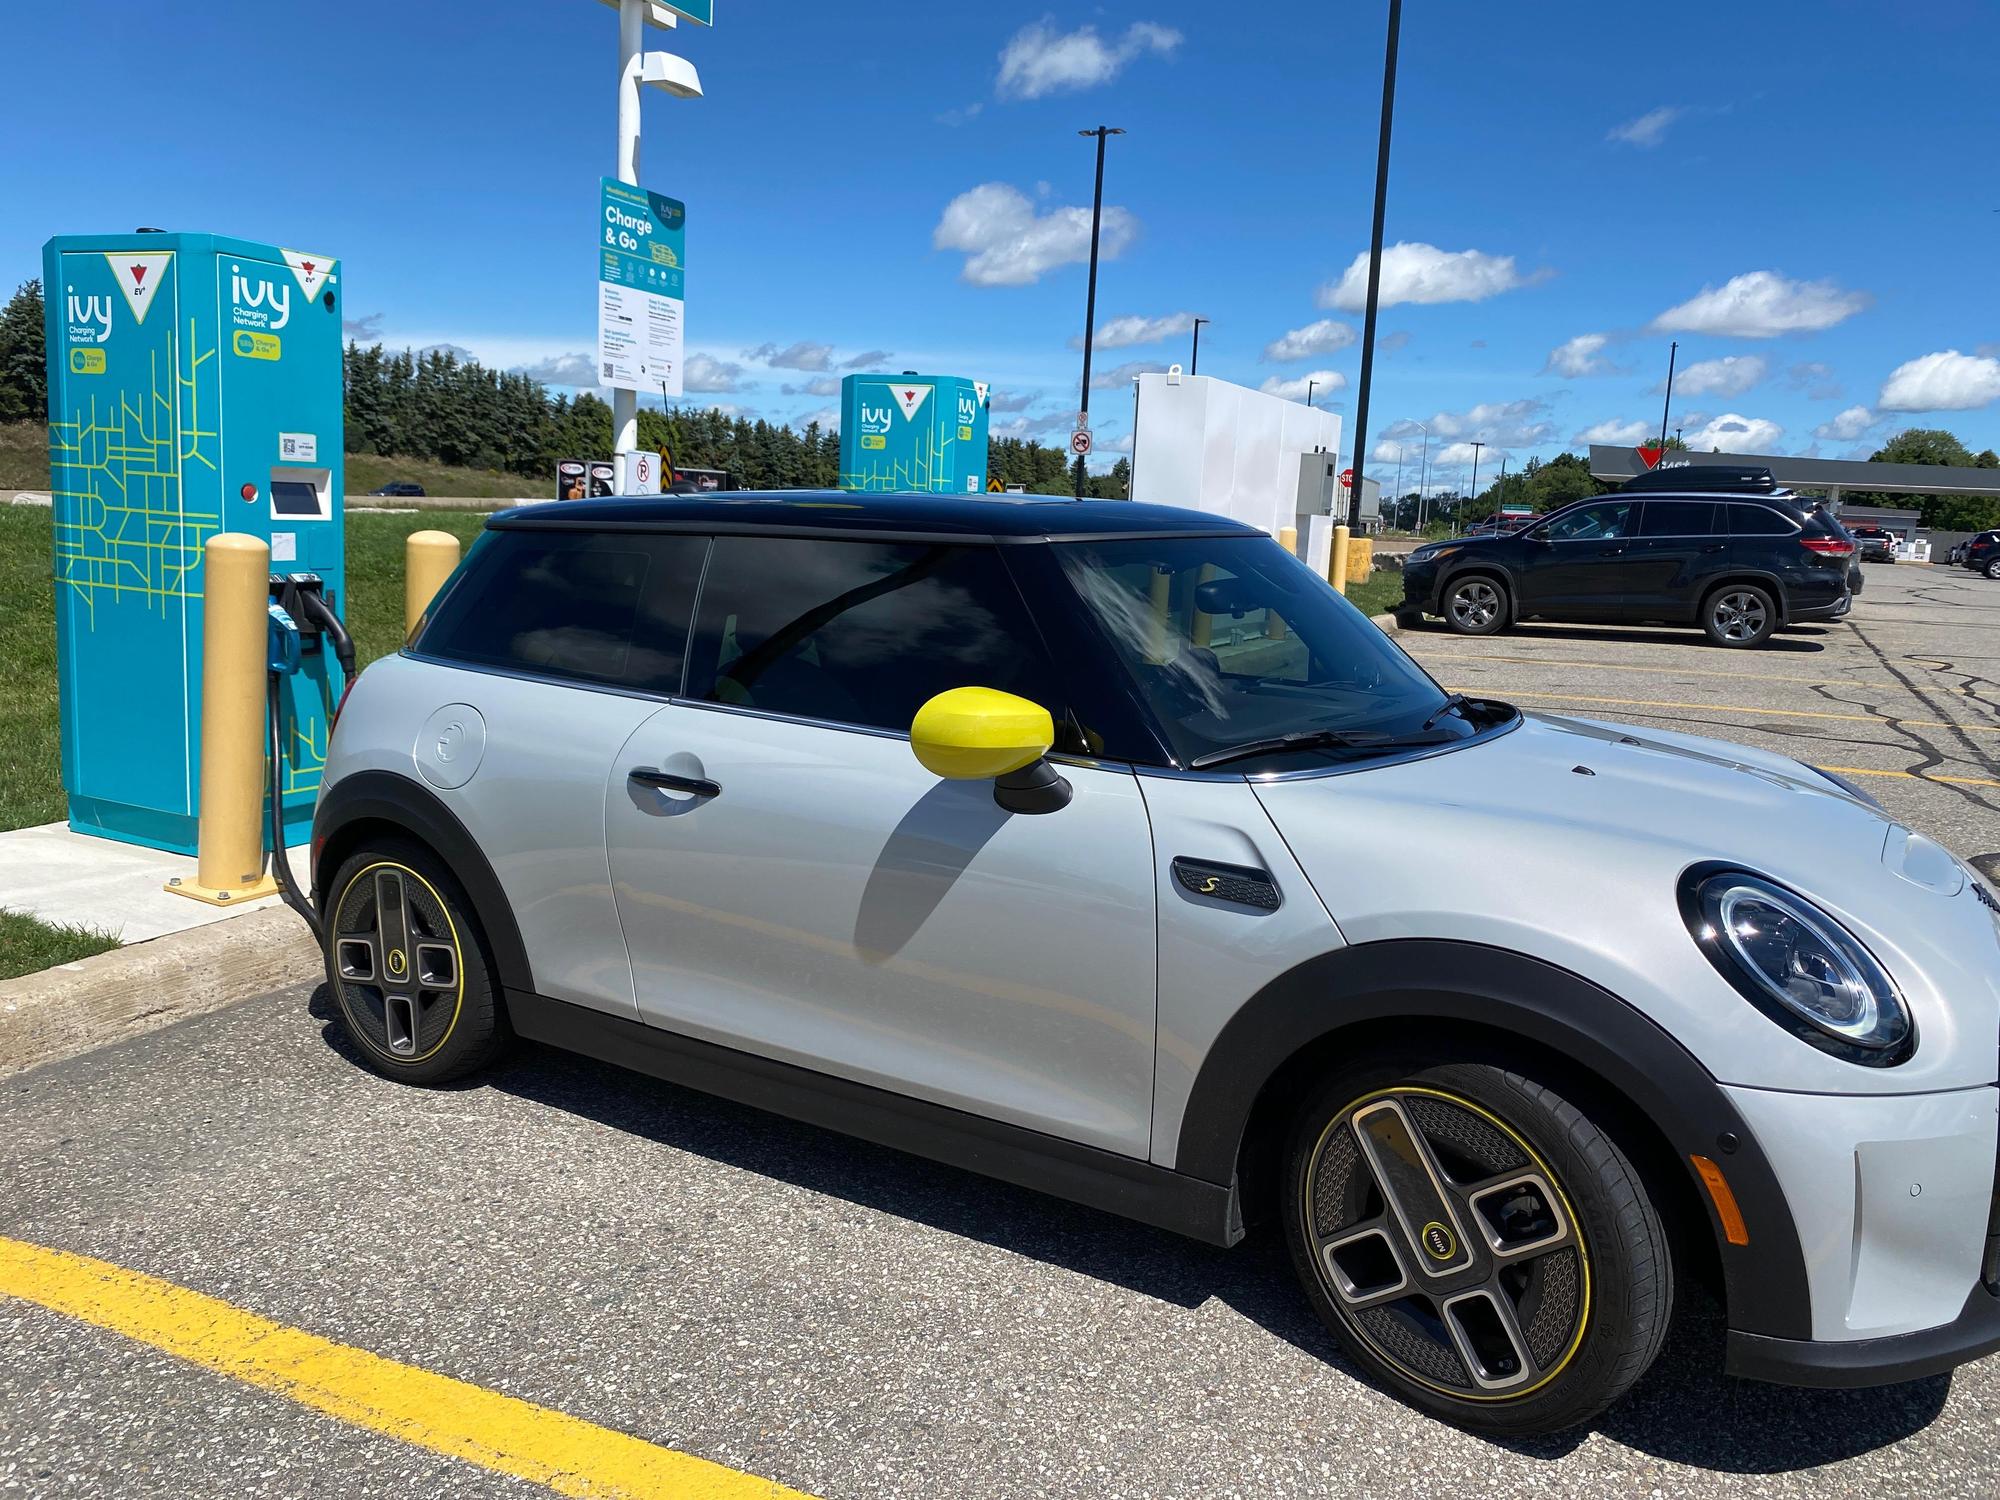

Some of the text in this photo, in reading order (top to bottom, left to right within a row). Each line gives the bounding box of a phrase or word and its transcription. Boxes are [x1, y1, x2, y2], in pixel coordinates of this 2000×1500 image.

[605, 205, 653, 236] Charge
[605, 227, 637, 251] & Go
[231, 264, 290, 330] ivy
[67, 285, 112, 343] ivy
[233, 306, 268, 321] Charging
[233, 315, 266, 329] Network
[69, 326, 96, 336] Charging
[69, 335, 94, 343] Network
[861, 402, 892, 433] ivy
[958, 391, 976, 424] ivy
[1341, 474, 1353, 483] STO
[1199, 877, 1219, 892] S
[1430, 1230, 1446, 1252] MINI
